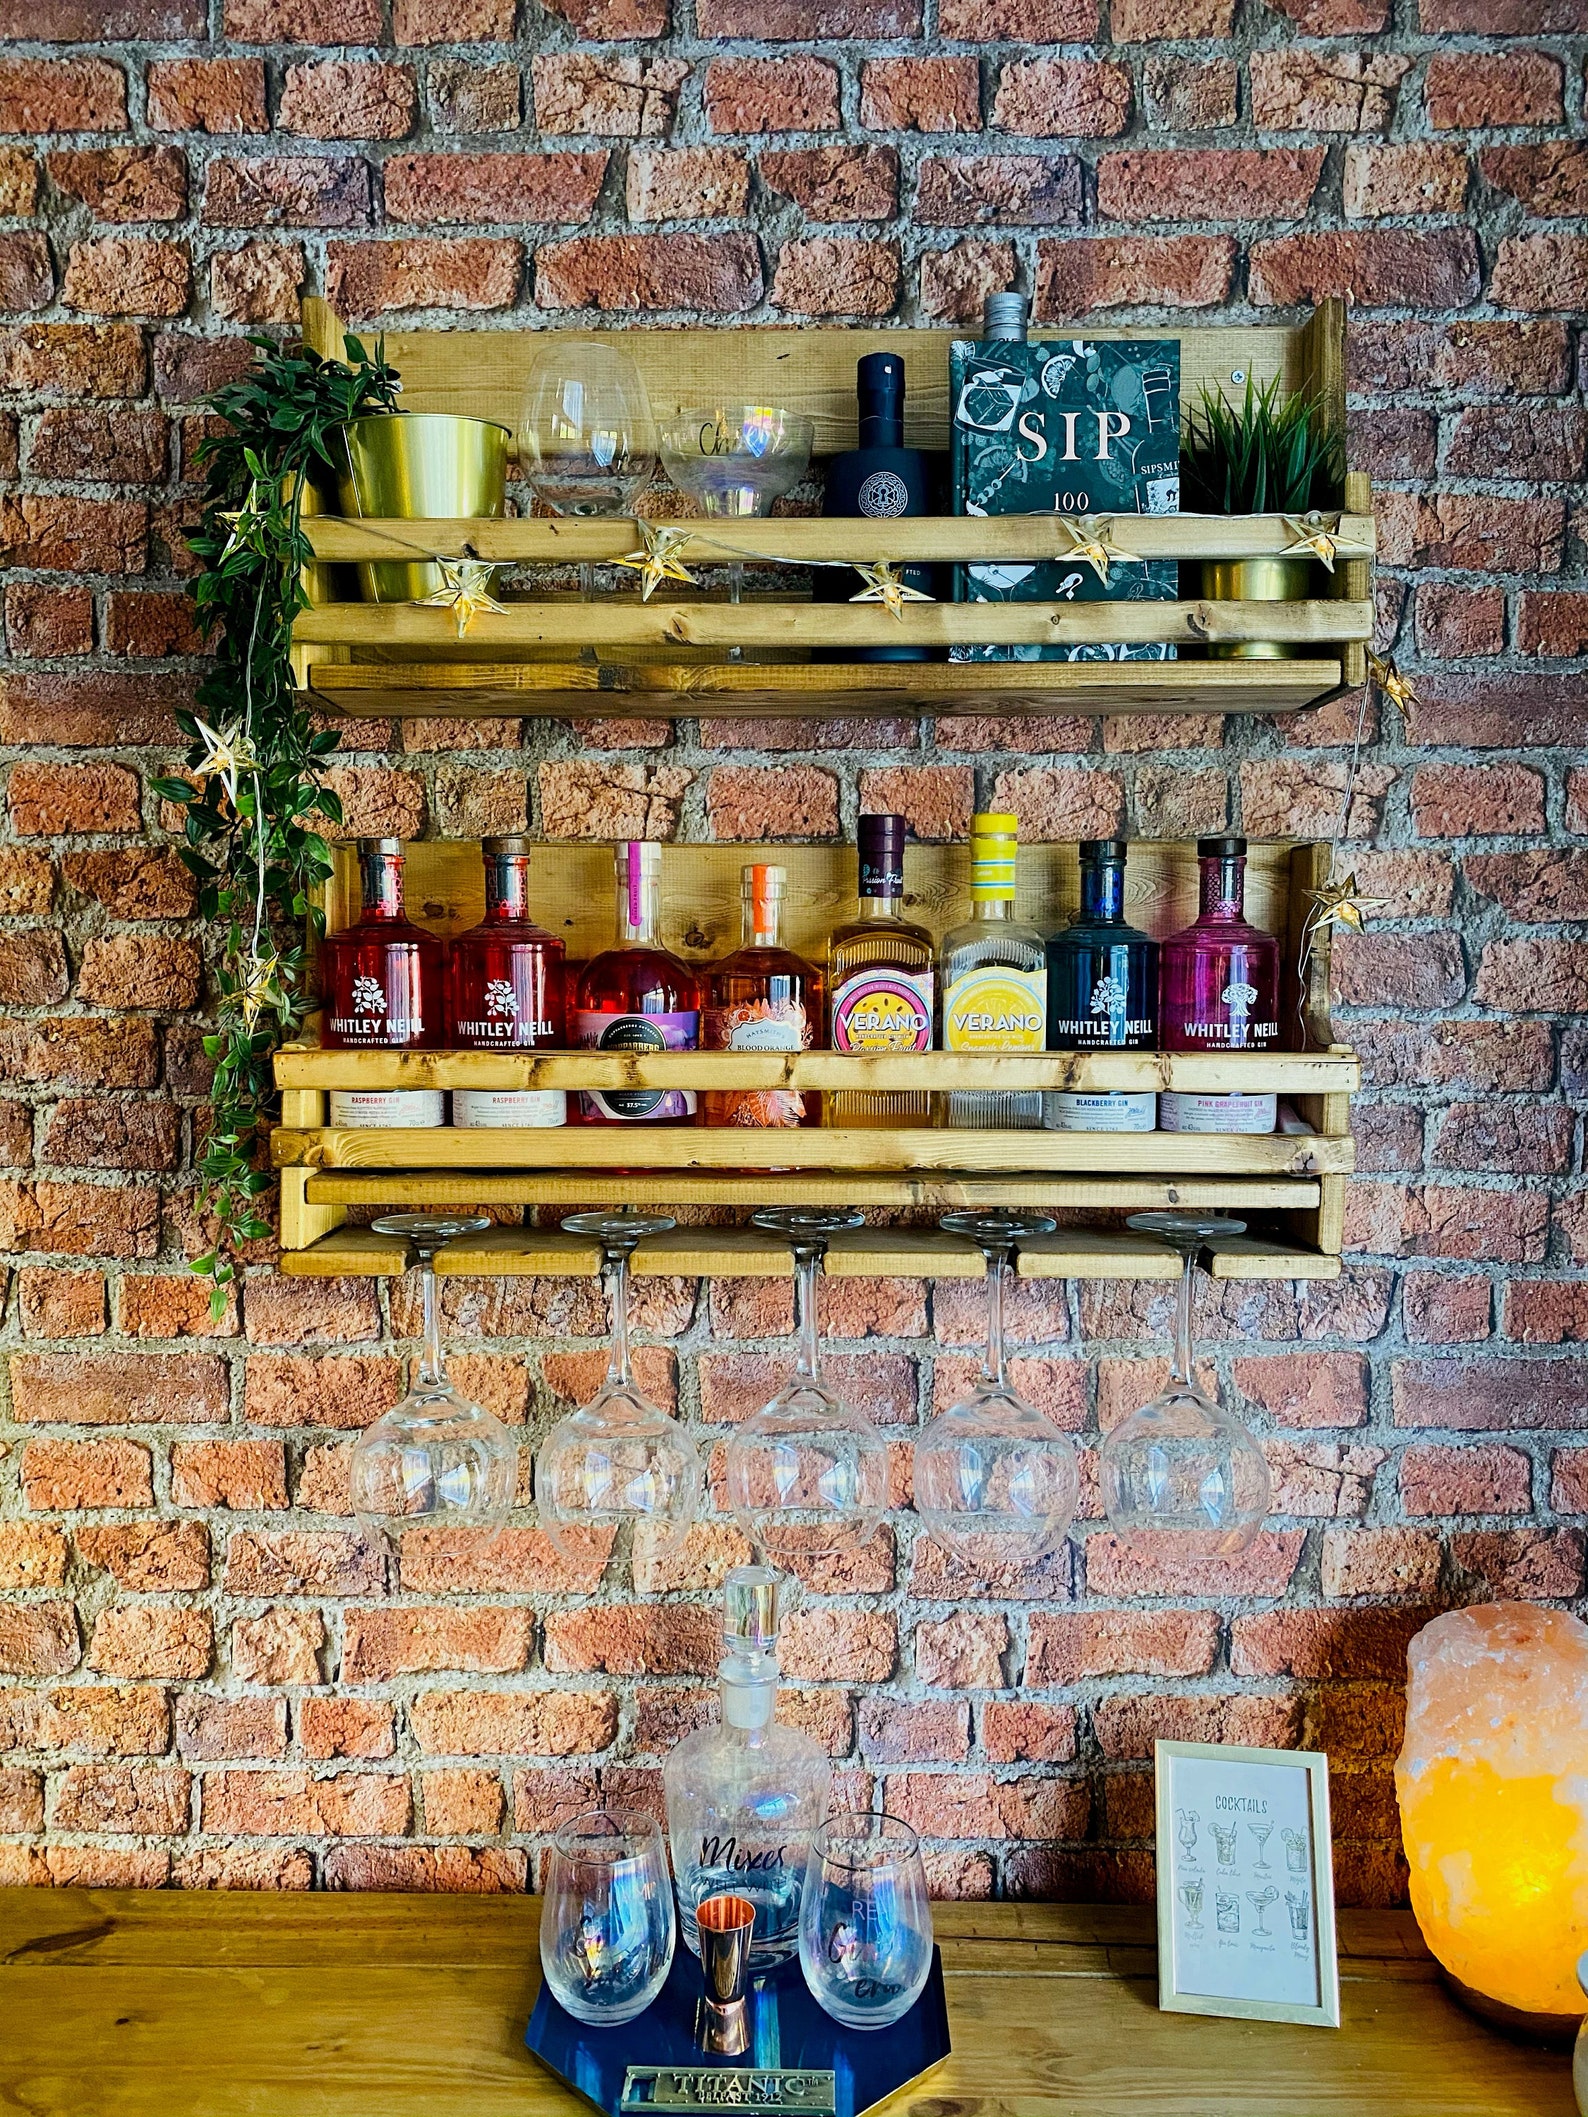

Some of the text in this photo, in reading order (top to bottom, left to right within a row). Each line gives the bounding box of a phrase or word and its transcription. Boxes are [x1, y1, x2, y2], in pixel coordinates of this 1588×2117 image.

[1016, 411, 1131, 462] SIP
[1054, 491, 1089, 511] 100
[329, 1018, 425, 1034] WHITLEY NEILL
[457, 1020, 555, 1037] WHITLEY NEILL
[839, 1013, 929, 1032] VERANO
[952, 1013, 1043, 1032] VERANO
[1058, 1019, 1153, 1035] WHITLEY NEILL
[1184, 1021, 1279, 1038] WHITLEY NEILL
[492, 1096, 529, 1104] RASPBERRY
[1214, 1100, 1253, 1108] GRAPEFRUIT
[1215, 1795, 1268, 1814] COCKTAILS
[699, 1836, 787, 1874] Mixes
[755, 2091, 783, 2102] 1912
